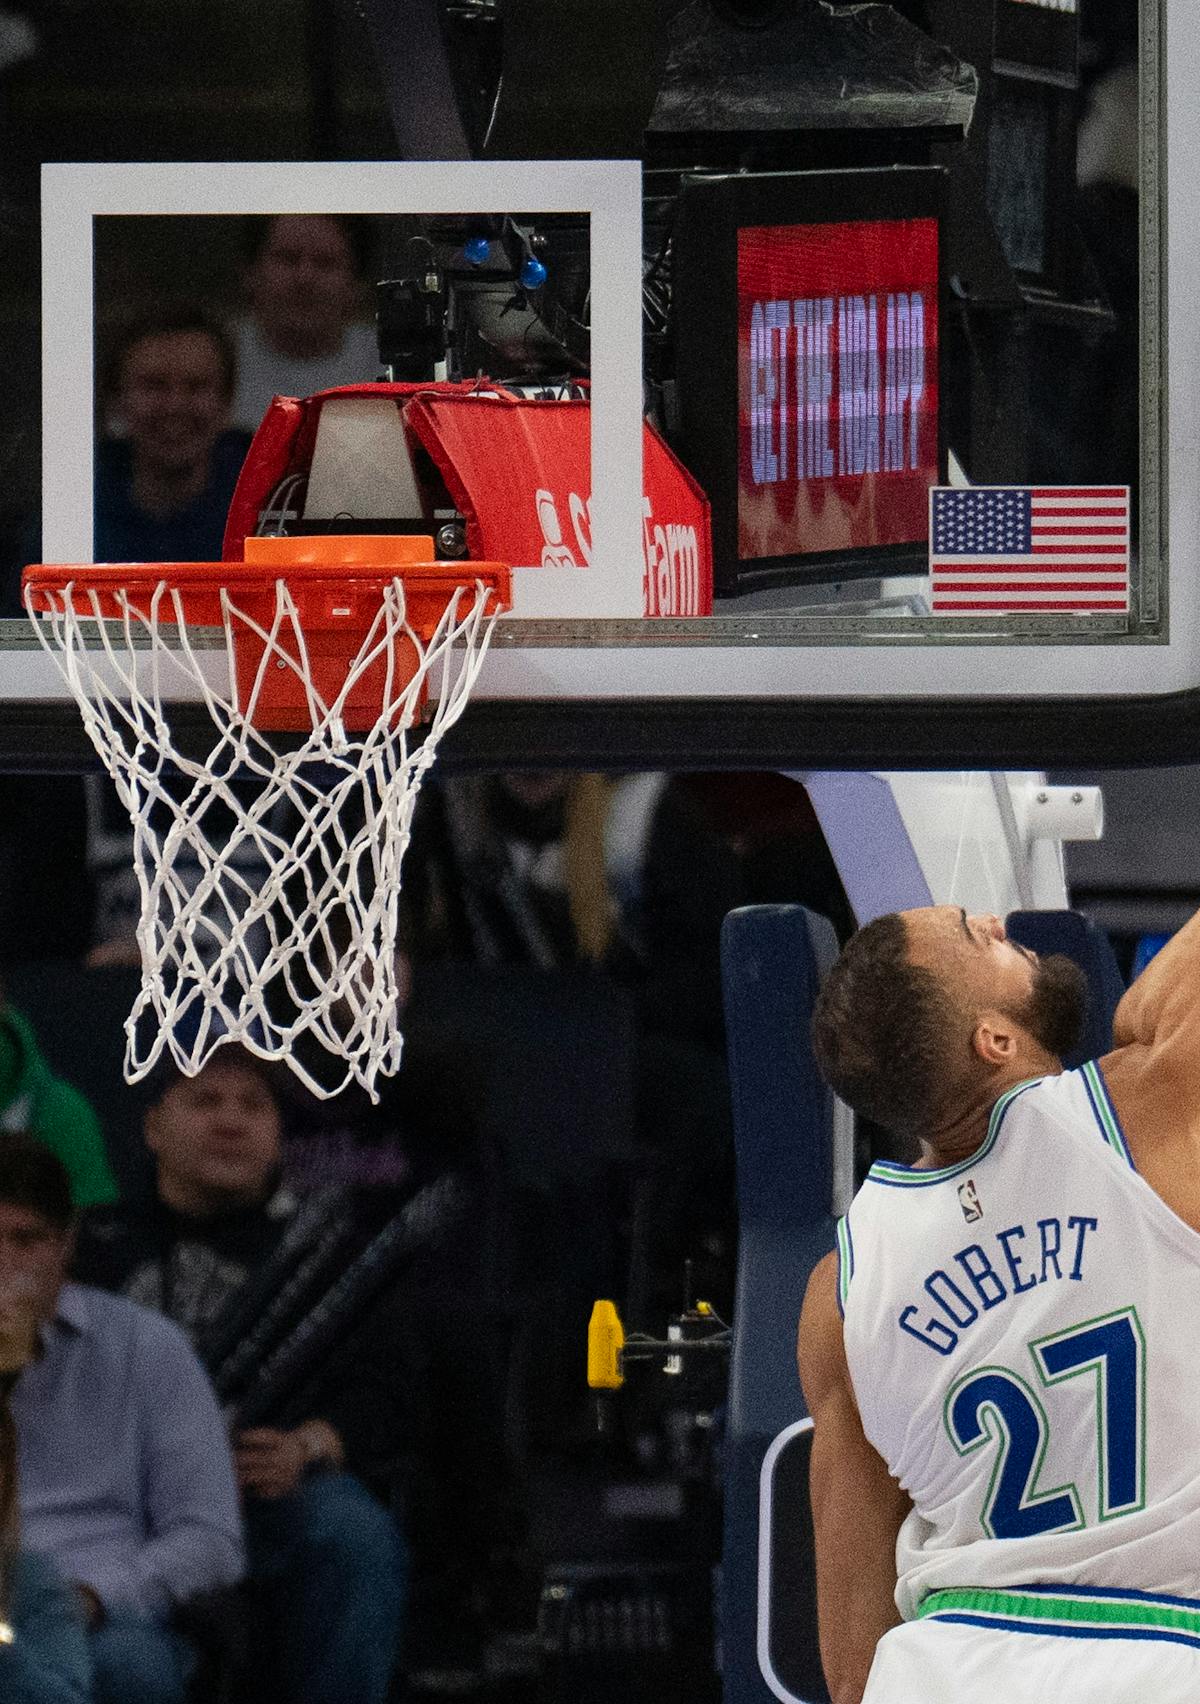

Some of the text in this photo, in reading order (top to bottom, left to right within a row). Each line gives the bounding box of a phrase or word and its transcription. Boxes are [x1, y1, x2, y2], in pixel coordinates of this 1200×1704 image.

[750, 300, 790, 485] GET
[794, 298, 834, 480] THE
[899, 1216, 1098, 1356] GOBERT
[943, 1305, 1147, 1540] 27
